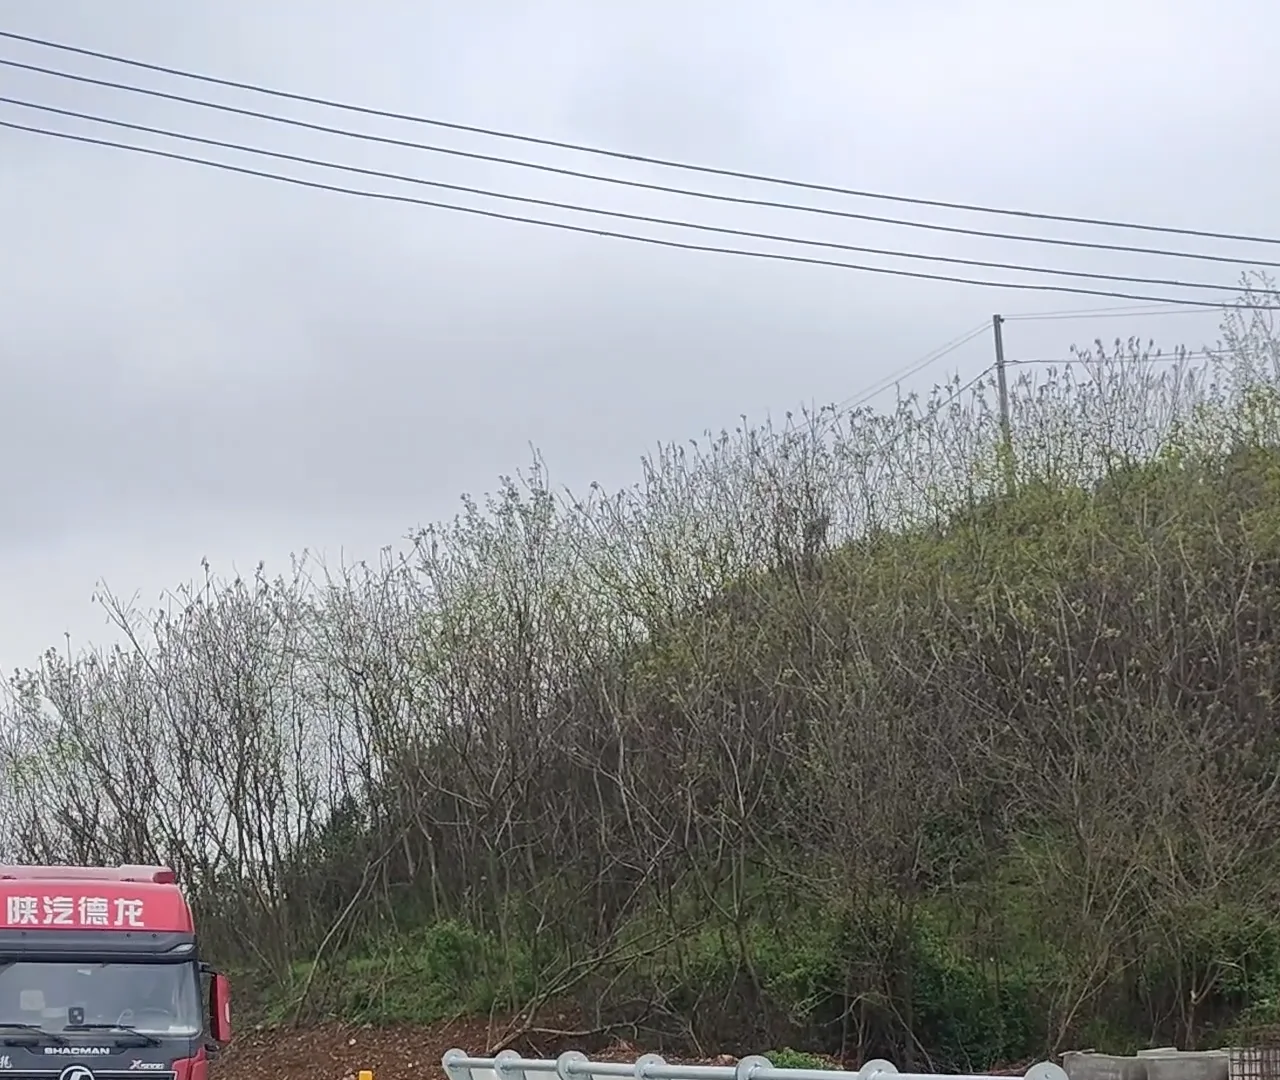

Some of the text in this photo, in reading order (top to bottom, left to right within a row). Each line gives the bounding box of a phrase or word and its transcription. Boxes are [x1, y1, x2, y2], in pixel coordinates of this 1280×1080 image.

[6, 895, 145, 927] 陕汽德龙
[44, 1047, 111, 1055] SHACMAN
